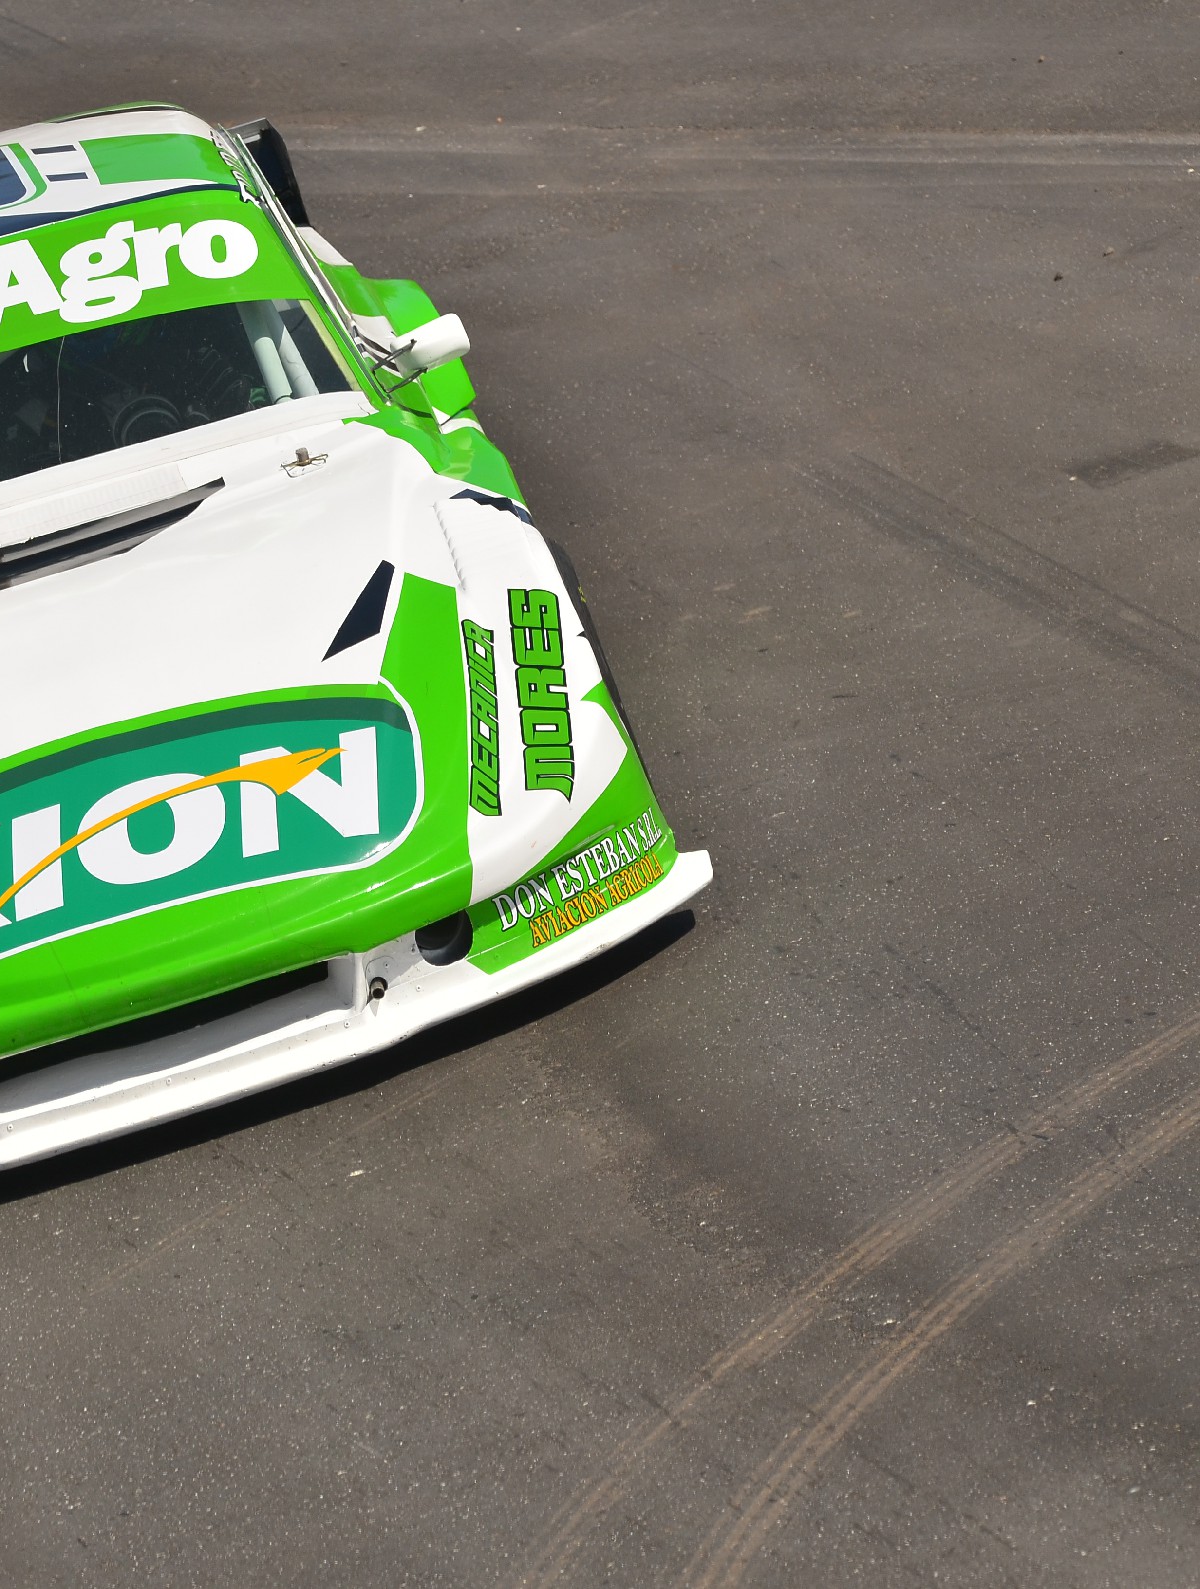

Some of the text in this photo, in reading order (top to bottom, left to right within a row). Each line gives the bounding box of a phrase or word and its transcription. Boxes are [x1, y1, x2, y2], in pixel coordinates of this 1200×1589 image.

[461, 618, 502, 817] MECANICA
[507, 588, 575, 803] MORES
[492, 872, 555, 932] DON
[551, 822, 642, 901] ESTEBAN
[529, 851, 665, 948] AVIACION AGRICOLA
